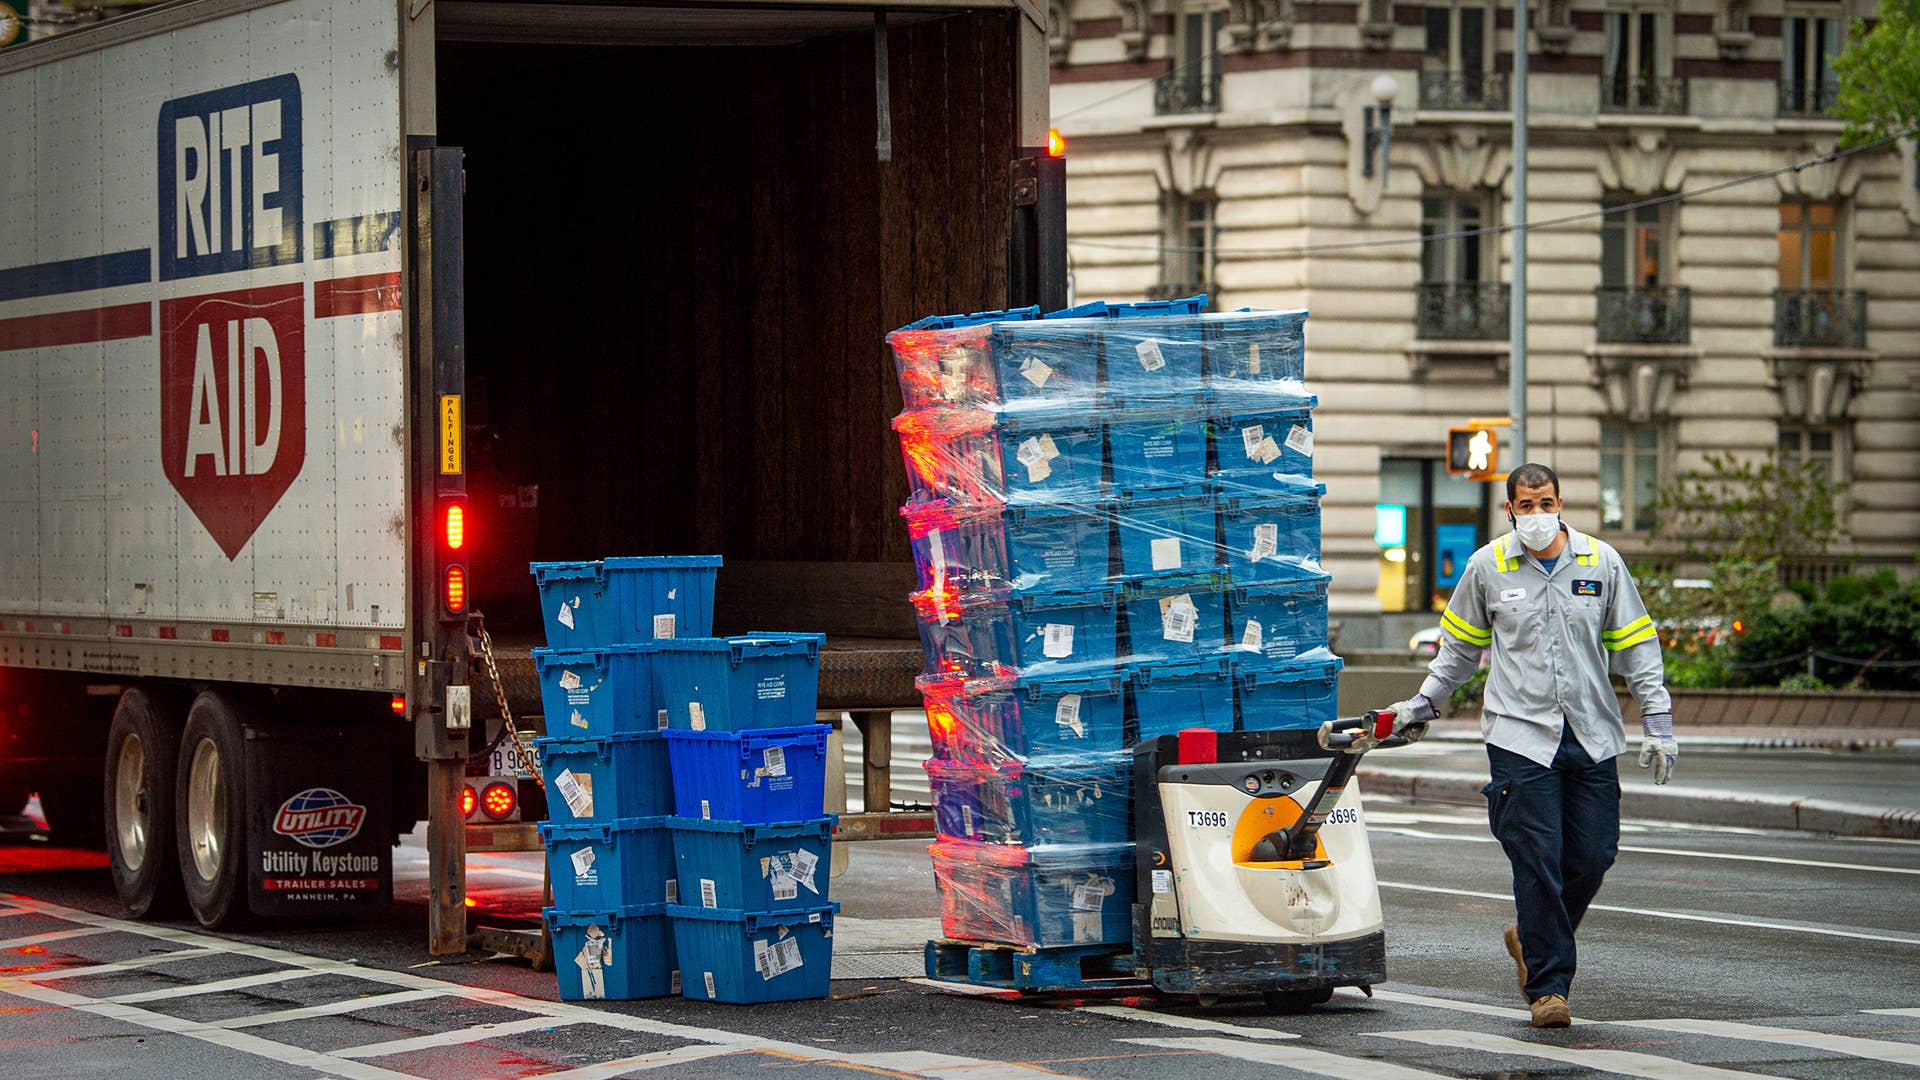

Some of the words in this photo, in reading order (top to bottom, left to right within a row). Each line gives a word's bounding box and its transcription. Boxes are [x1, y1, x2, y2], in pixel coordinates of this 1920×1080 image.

[175, 98, 283, 260] RITE
[184, 316, 282, 477] AID
[446, 399, 455, 471] PALFINGER
[282, 809, 357, 830] UTILITY
[1188, 811, 1227, 827] T3696
[1325, 808, 1357, 824] 3696
[263, 851, 307, 876] Utility
[313, 851, 378, 876] Keystone
[276, 880, 326, 889] TRAILER
[330, 880, 366, 889] SALES
[287, 893, 338, 902] MANHEIM,
[343, 893, 356, 901] PA
